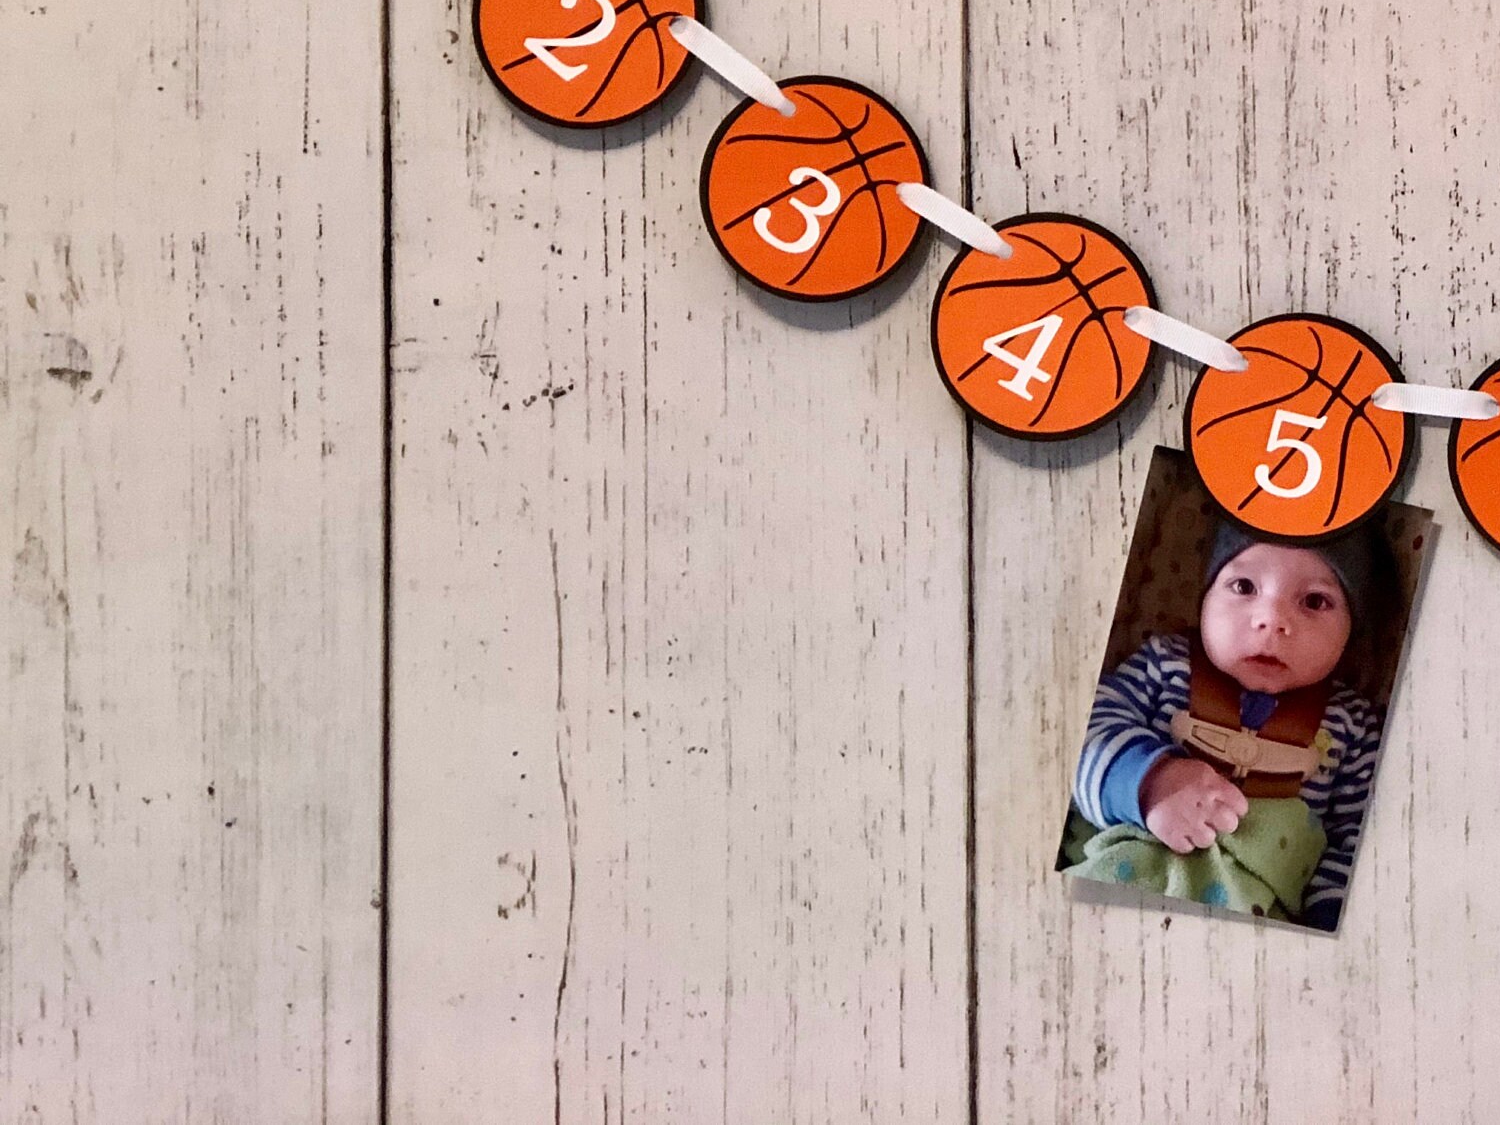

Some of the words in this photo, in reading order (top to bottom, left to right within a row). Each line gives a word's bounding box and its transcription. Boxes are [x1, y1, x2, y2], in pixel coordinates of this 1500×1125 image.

[752, 166, 842, 255] 3
[982, 313, 1064, 402] 4
[1253, 408, 1329, 499] 5
